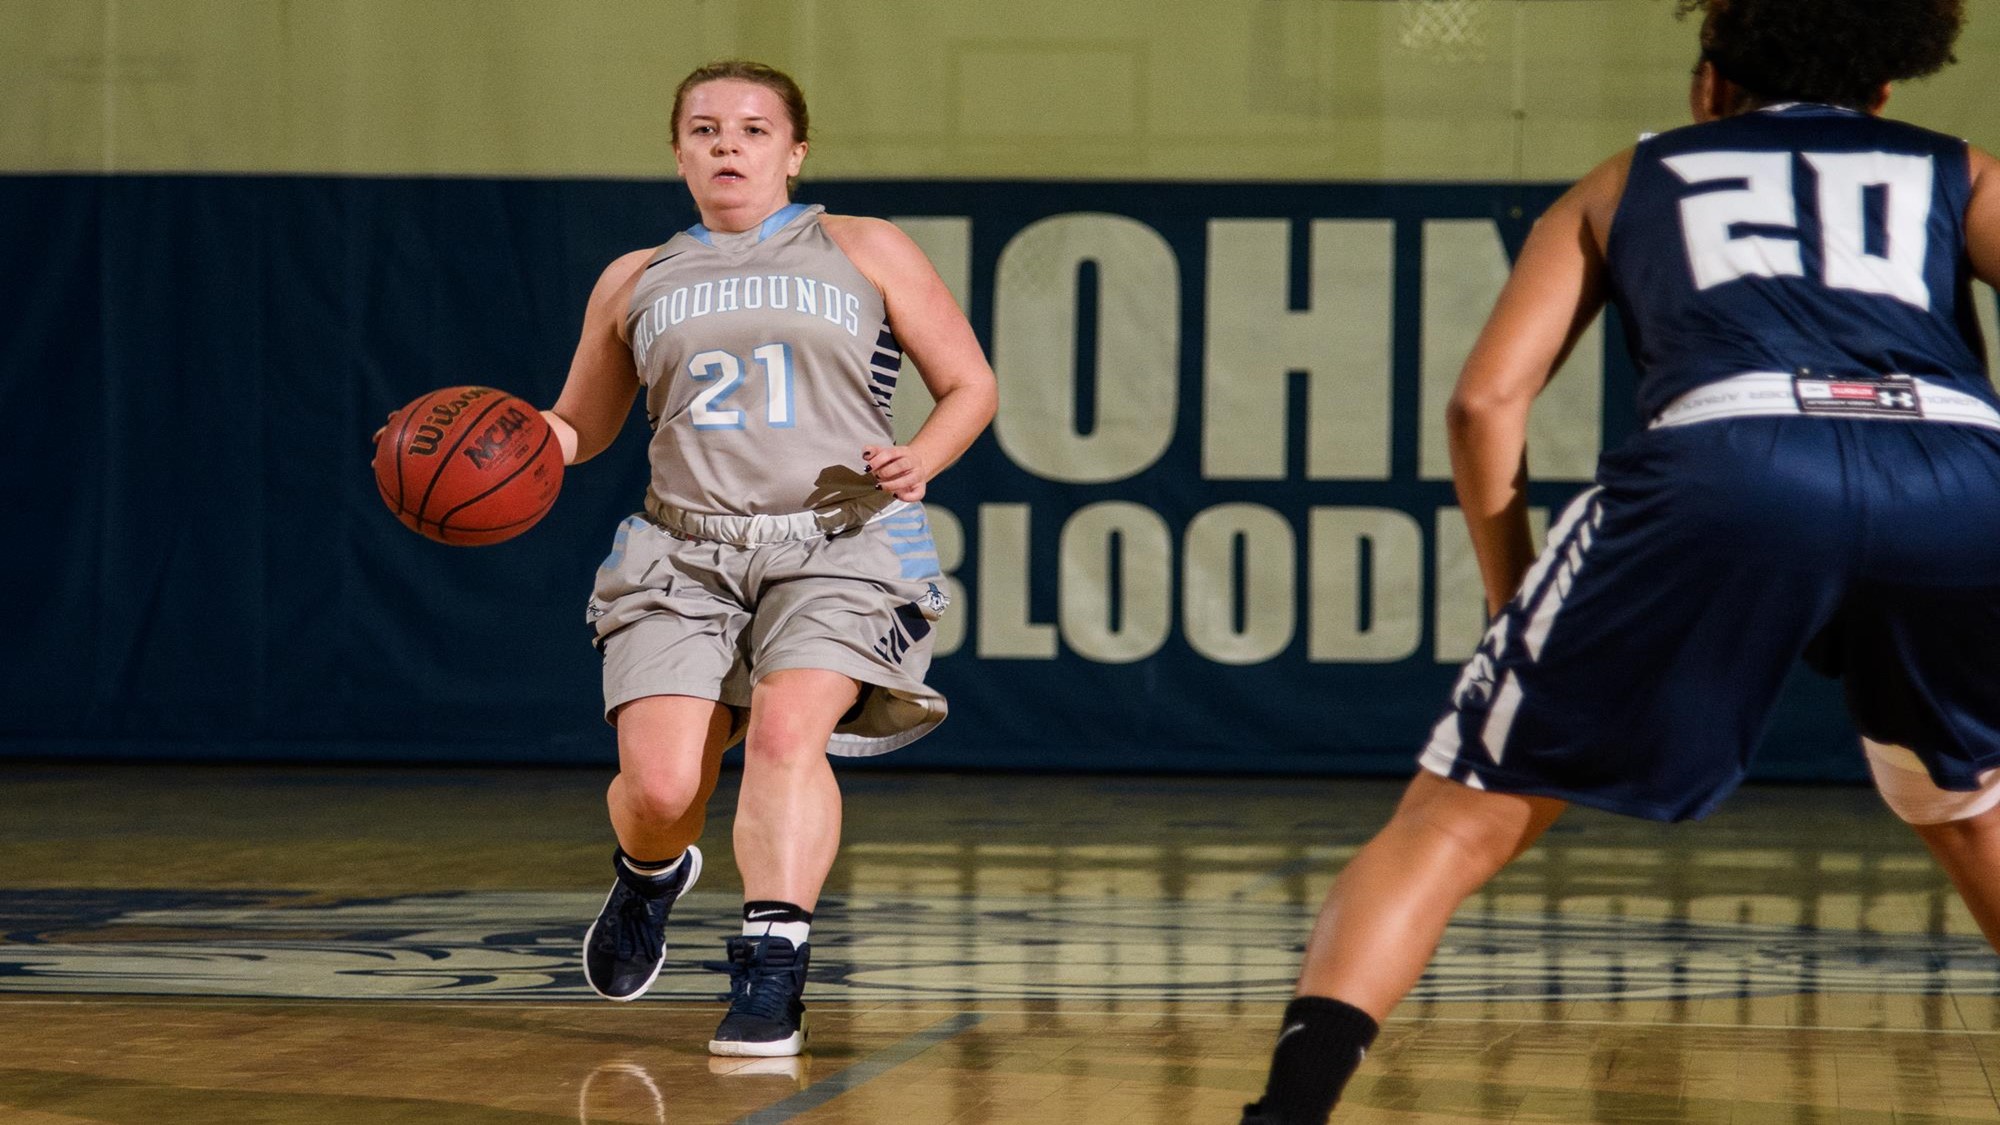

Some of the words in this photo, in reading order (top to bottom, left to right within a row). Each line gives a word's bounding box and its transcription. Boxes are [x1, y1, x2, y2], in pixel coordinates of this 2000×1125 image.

[1660, 150, 1933, 312] 20
[688, 343, 795, 430] 21
[463, 405, 531, 470] NCAA
